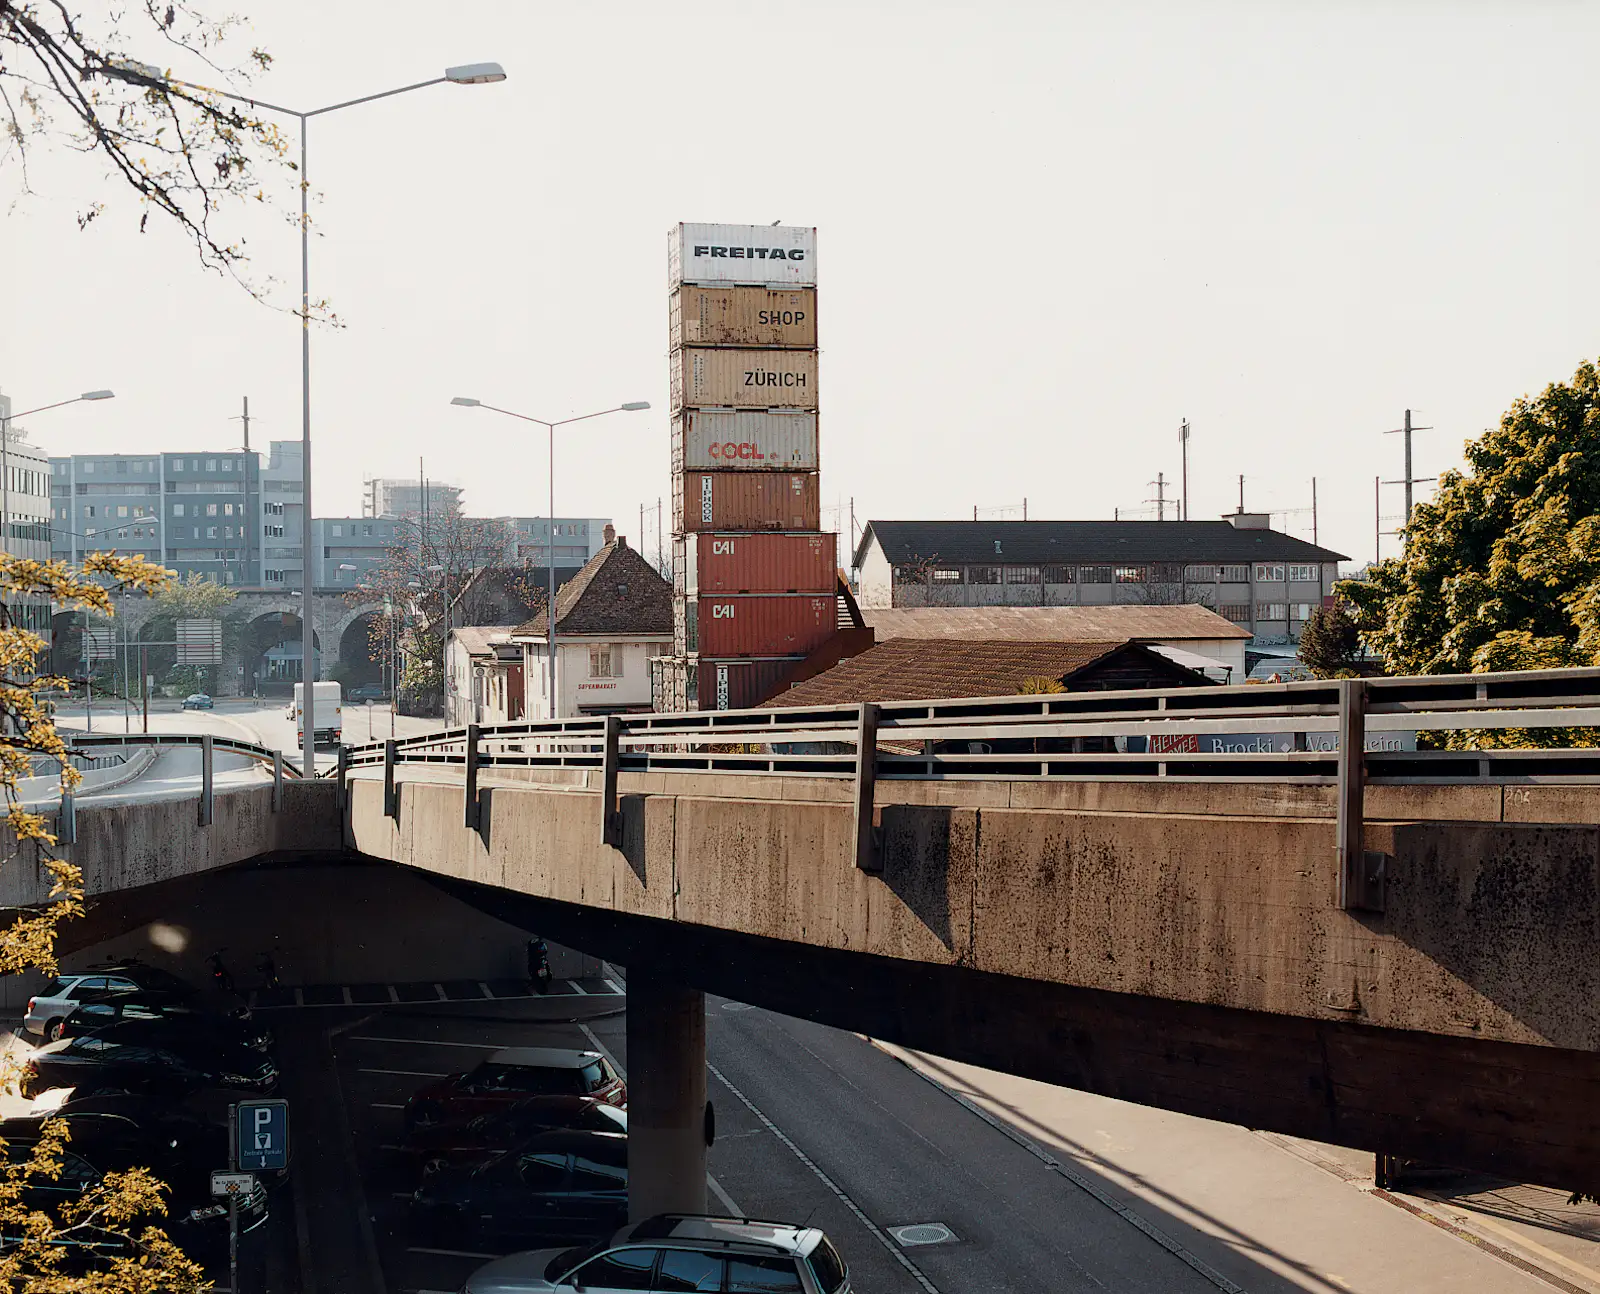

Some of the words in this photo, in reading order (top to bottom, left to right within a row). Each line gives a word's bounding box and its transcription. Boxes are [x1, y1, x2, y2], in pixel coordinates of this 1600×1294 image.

[694, 246, 804, 260] FREITAG
[758, 311, 805, 325] SHOP
[744, 368, 806, 387] ZÜRICH
[703, 477, 712, 521] TIPHOOK
[713, 541, 735, 555] CAI
[713, 605, 735, 619] CAI
[1212, 737, 1272, 753] Brocki
[255, 1109, 271, 1132] P
